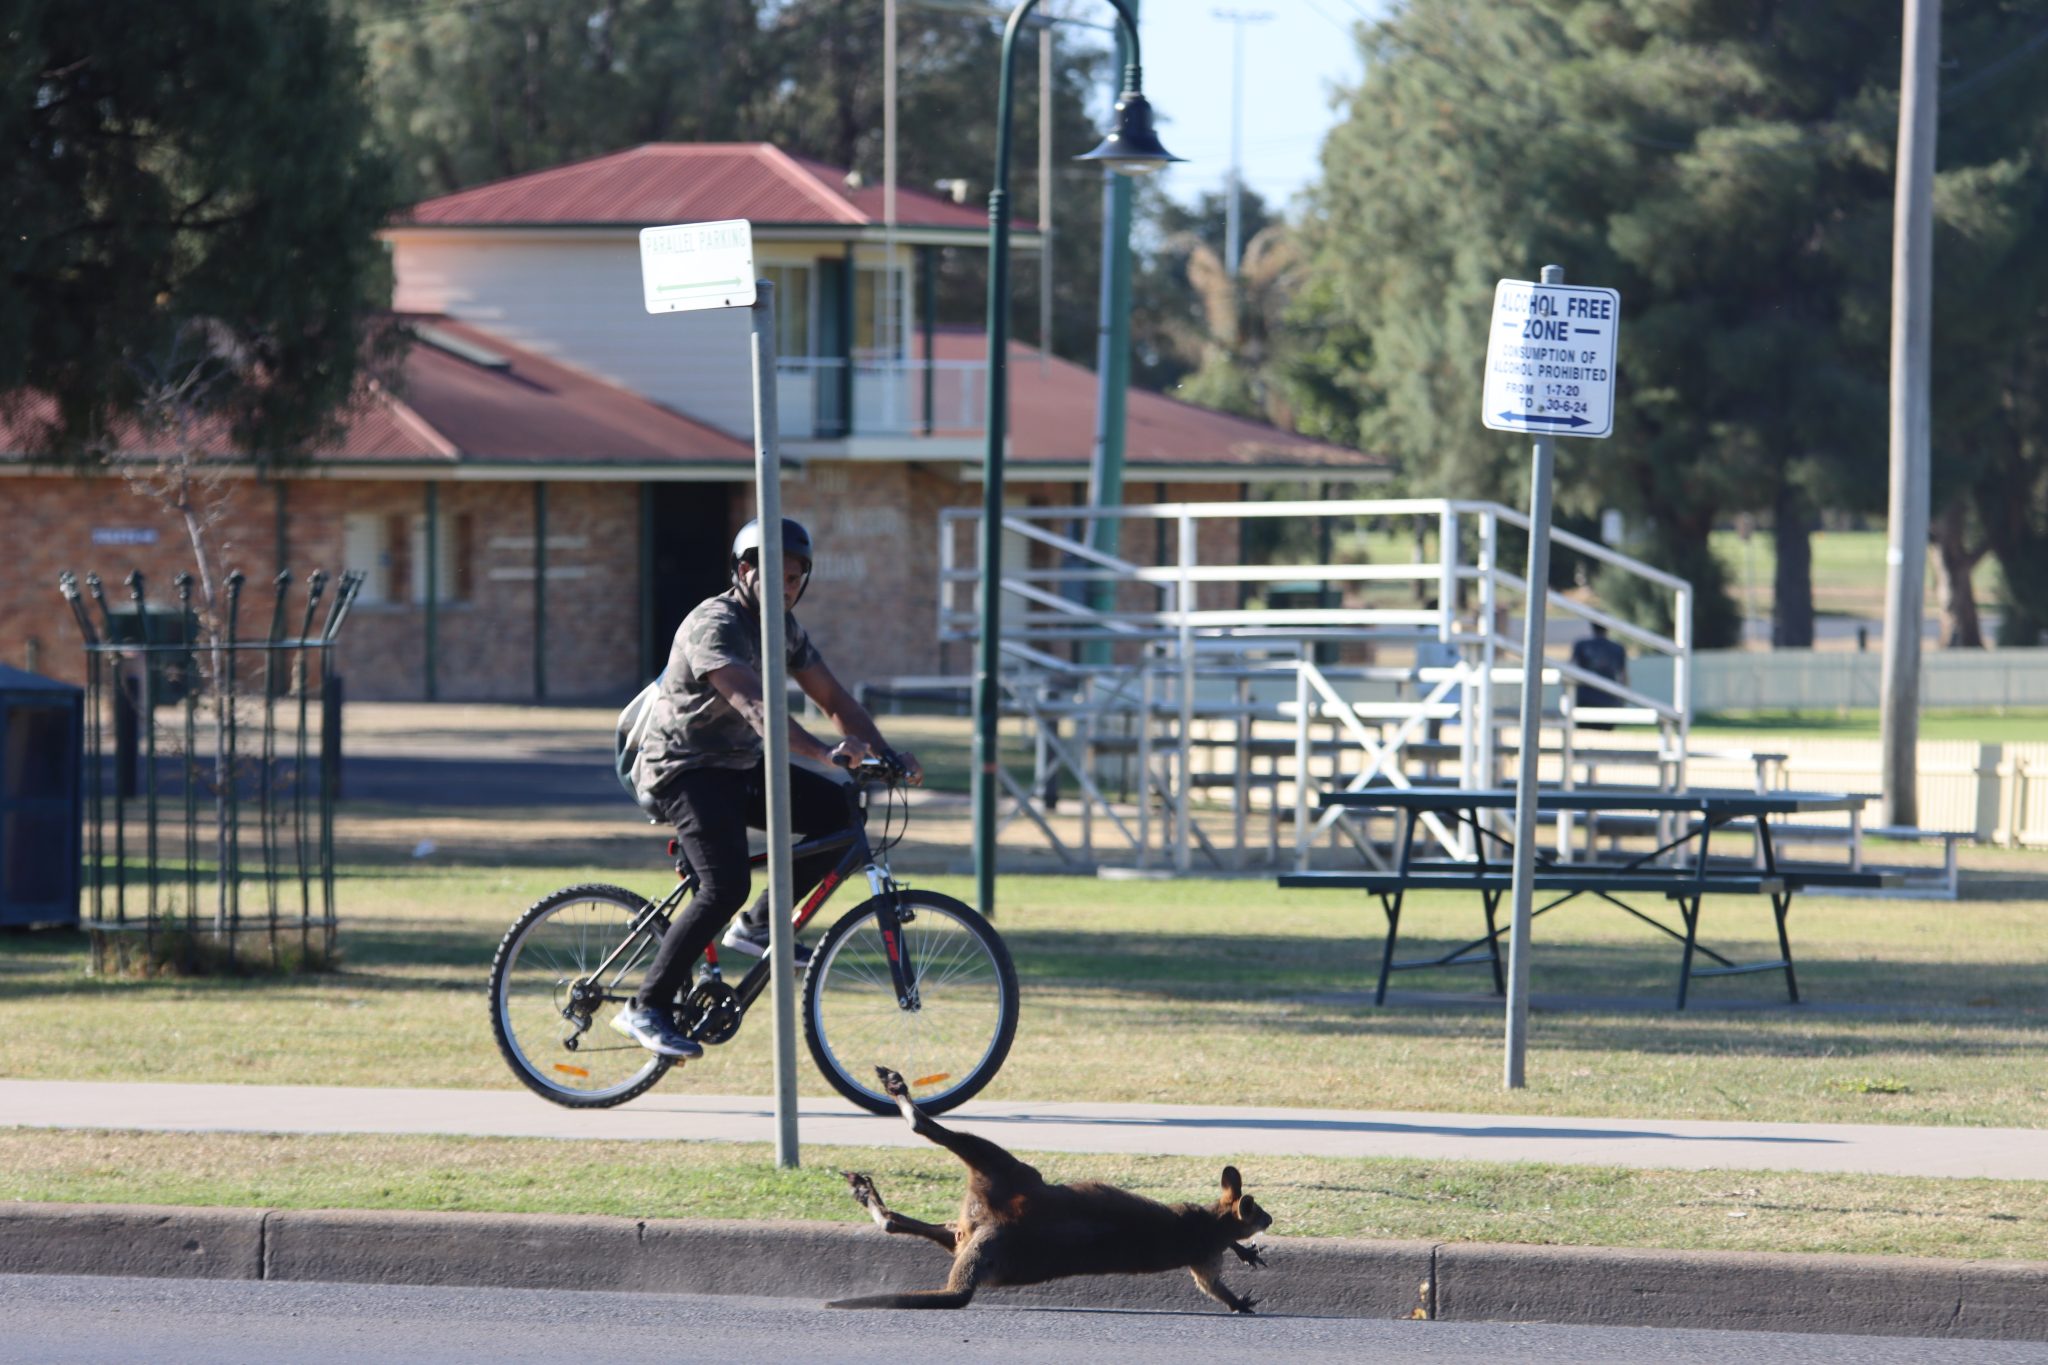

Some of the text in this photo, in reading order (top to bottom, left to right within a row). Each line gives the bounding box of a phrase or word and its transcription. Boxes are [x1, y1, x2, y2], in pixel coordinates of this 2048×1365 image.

[645, 227, 746, 254] PARALLEL PARKING
[1501, 292, 1611, 320] ALCOHOL FREE
[1522, 319, 1569, 341] ZONE
[1503, 344, 1597, 364] CONSUMPTION OF
[1494, 360, 1608, 382] ALCOHOL PROHIBITED
[1505, 382, 1580, 397] FROM 1-7-20
[1520, 397, 1588, 413] TO 30-6-24
